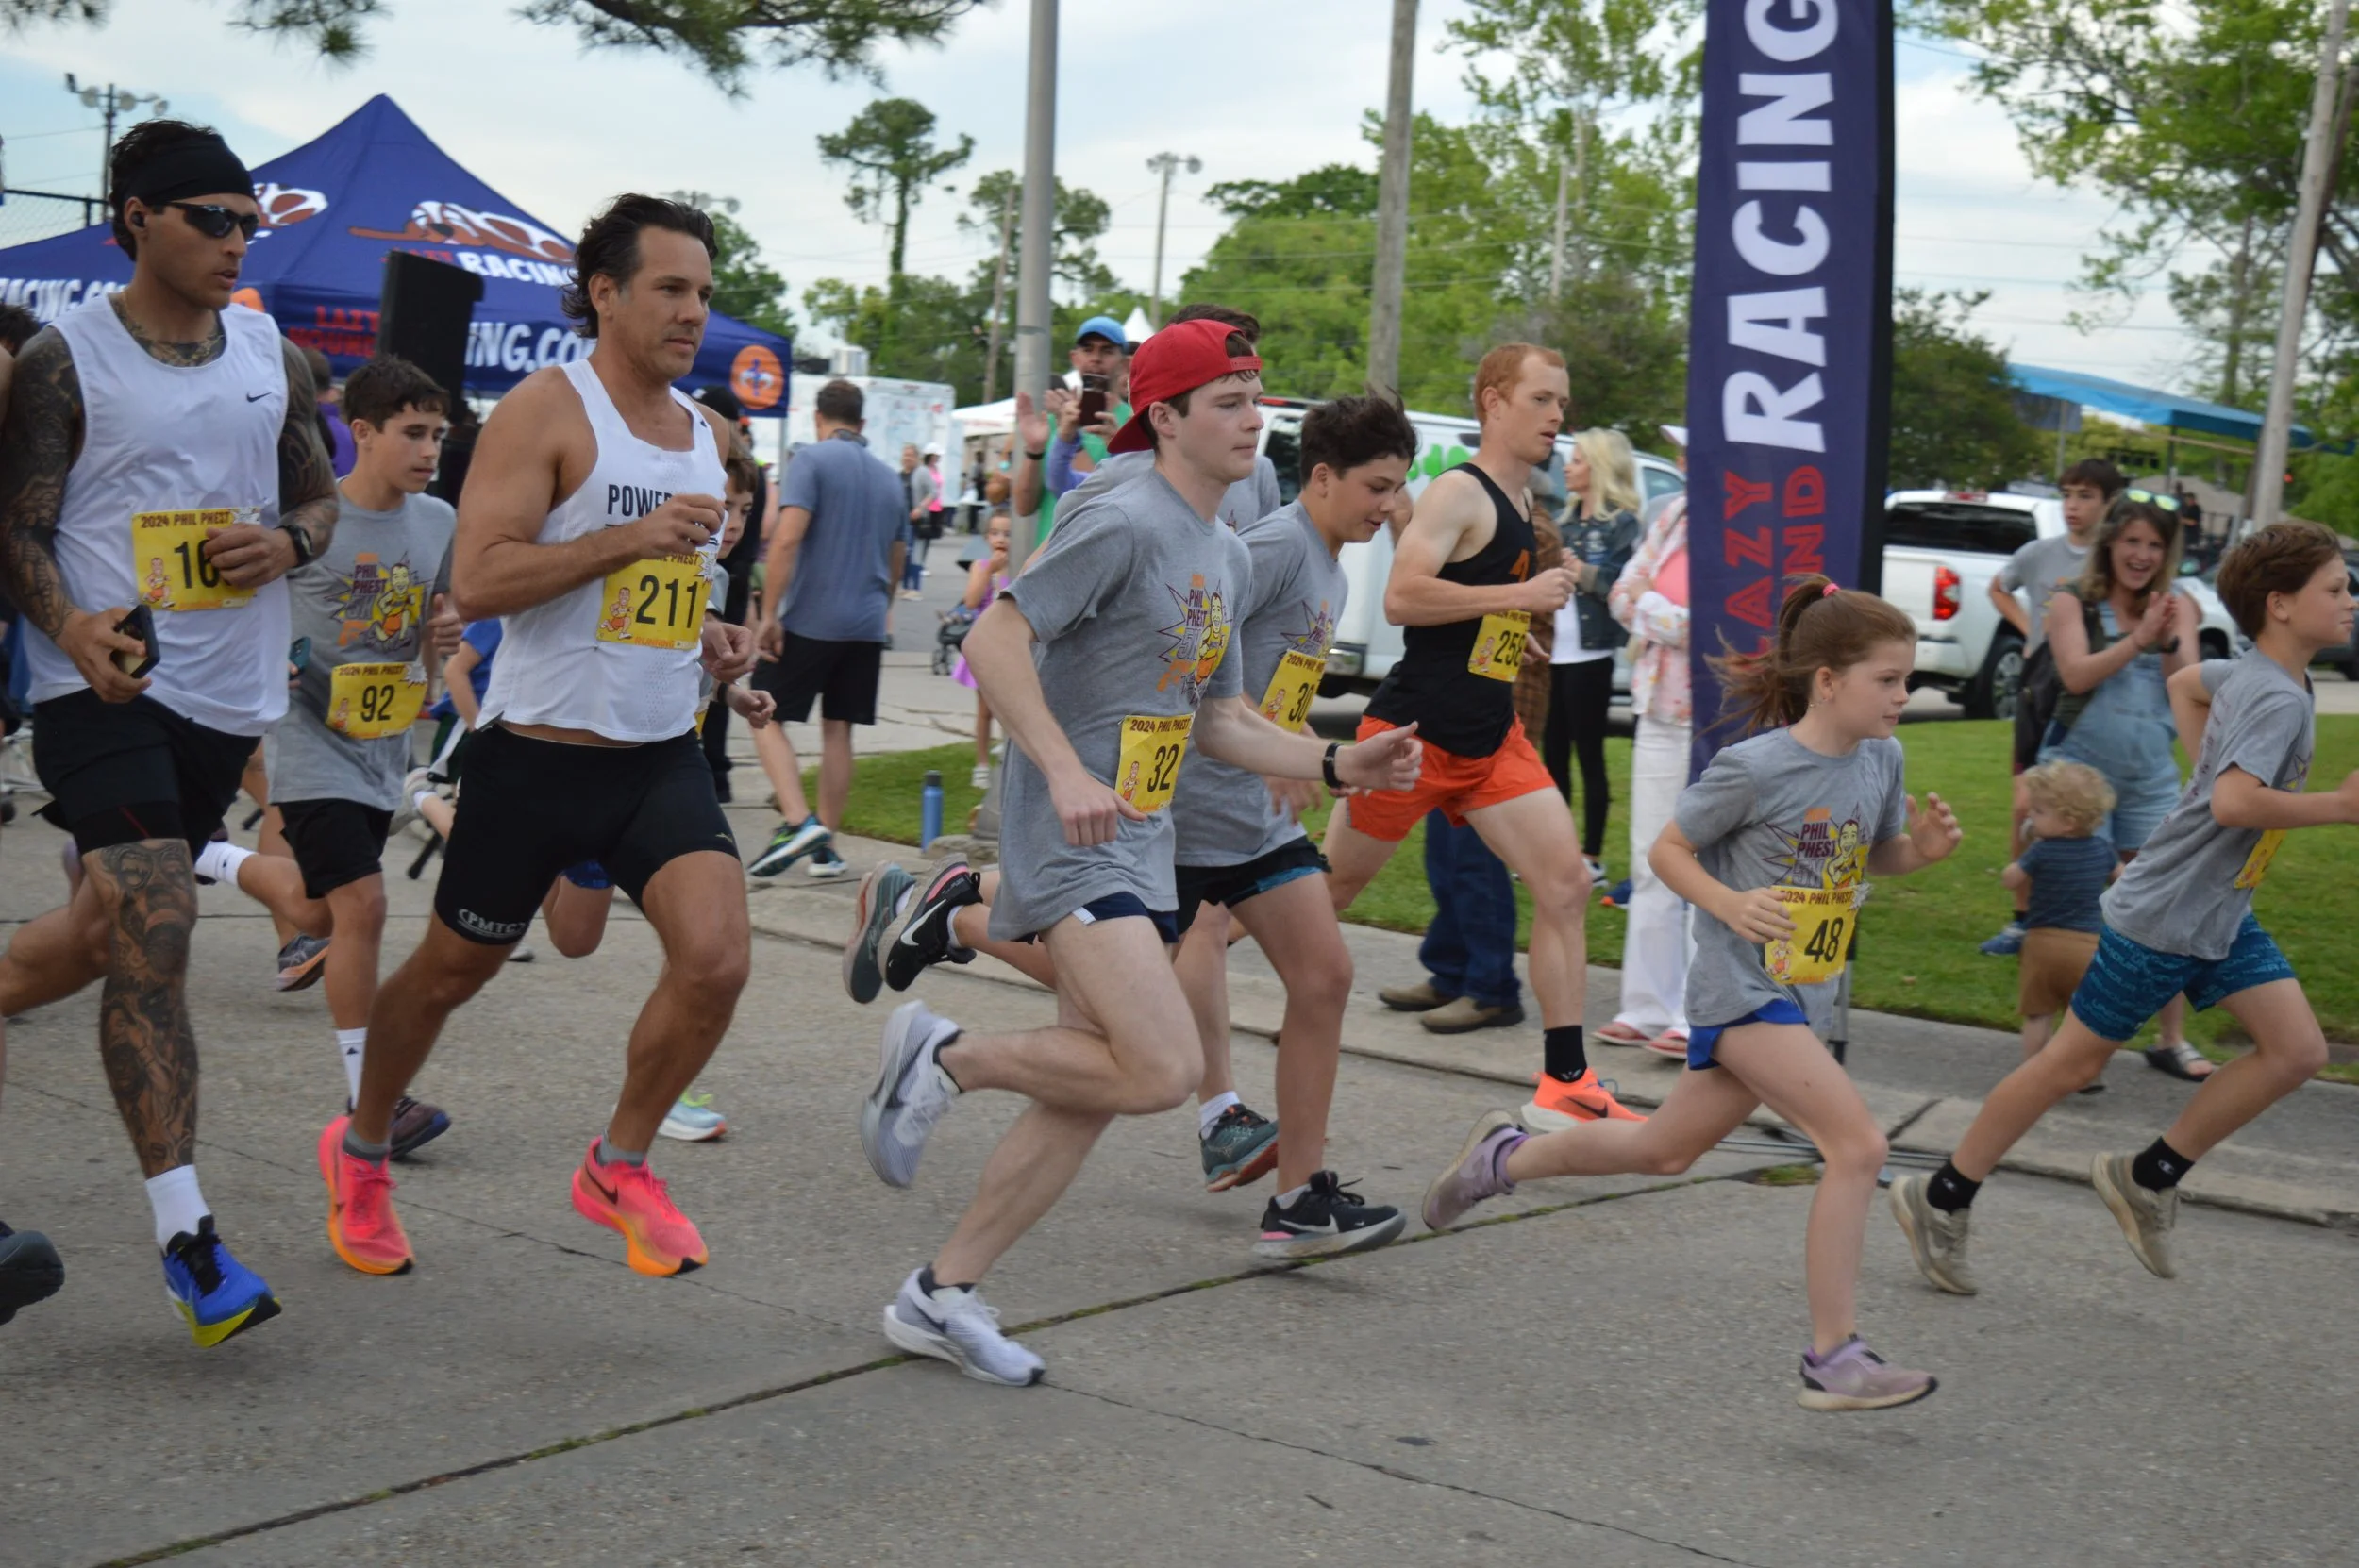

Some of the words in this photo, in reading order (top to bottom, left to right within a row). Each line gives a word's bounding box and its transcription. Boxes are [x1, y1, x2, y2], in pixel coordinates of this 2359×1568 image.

[1722, 0, 1839, 453] RACING
[141, 514, 170, 528] 2024
[173, 513, 196, 526] PHIL
[200, 511, 231, 525] PHEST
[174, 539, 232, 590] 16
[635, 575, 699, 629] 211
[1189, 588, 1205, 608] PHIL
[360, 684, 395, 722] 92
[1129, 719, 1156, 733] 2024
[1157, 720, 1172, 733] PHIL
[1172, 718, 1192, 732] PHEST
[1146, 743, 1180, 792] 32
[1800, 822, 1829, 841] PHIL
[1796, 840, 1837, 859] PHEST
[1808, 892, 1830, 905] PHIL
[1804, 916, 1845, 963] 48
